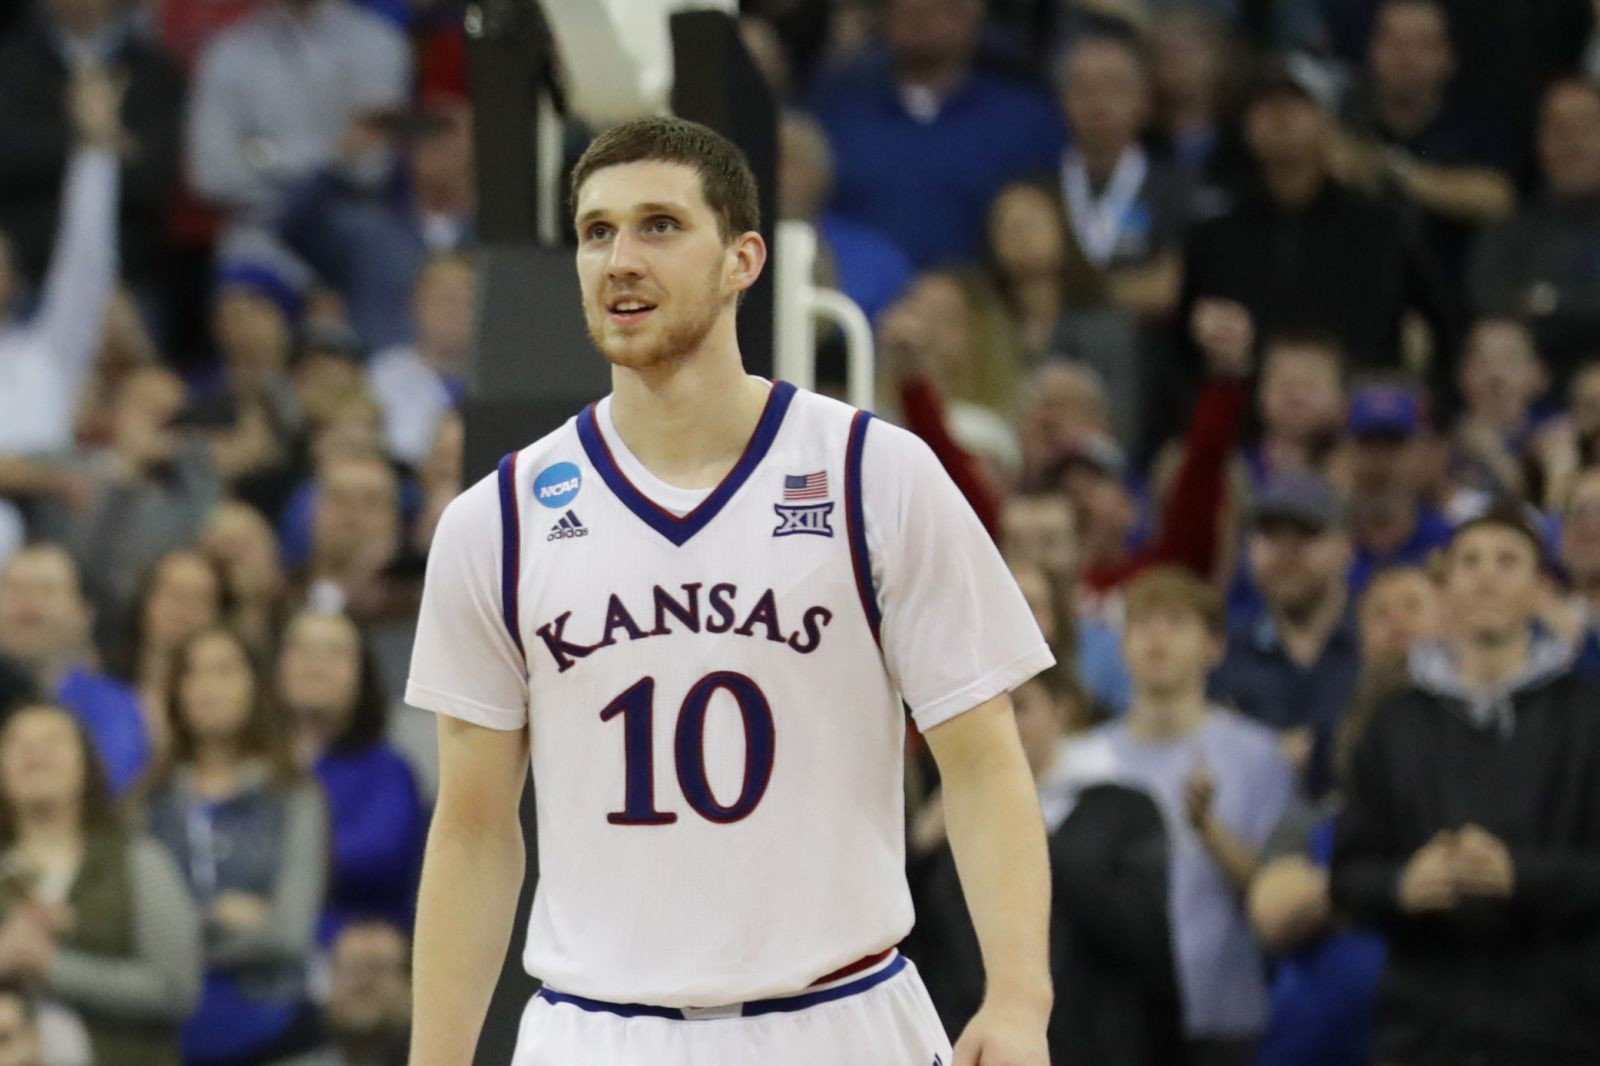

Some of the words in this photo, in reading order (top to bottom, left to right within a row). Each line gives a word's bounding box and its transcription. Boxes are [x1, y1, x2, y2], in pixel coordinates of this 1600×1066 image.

[540, 477, 579, 498] NCAA
[547, 526, 589, 542] adidas
[536, 582, 832, 673] KANSAS
[600, 670, 776, 826] 10
